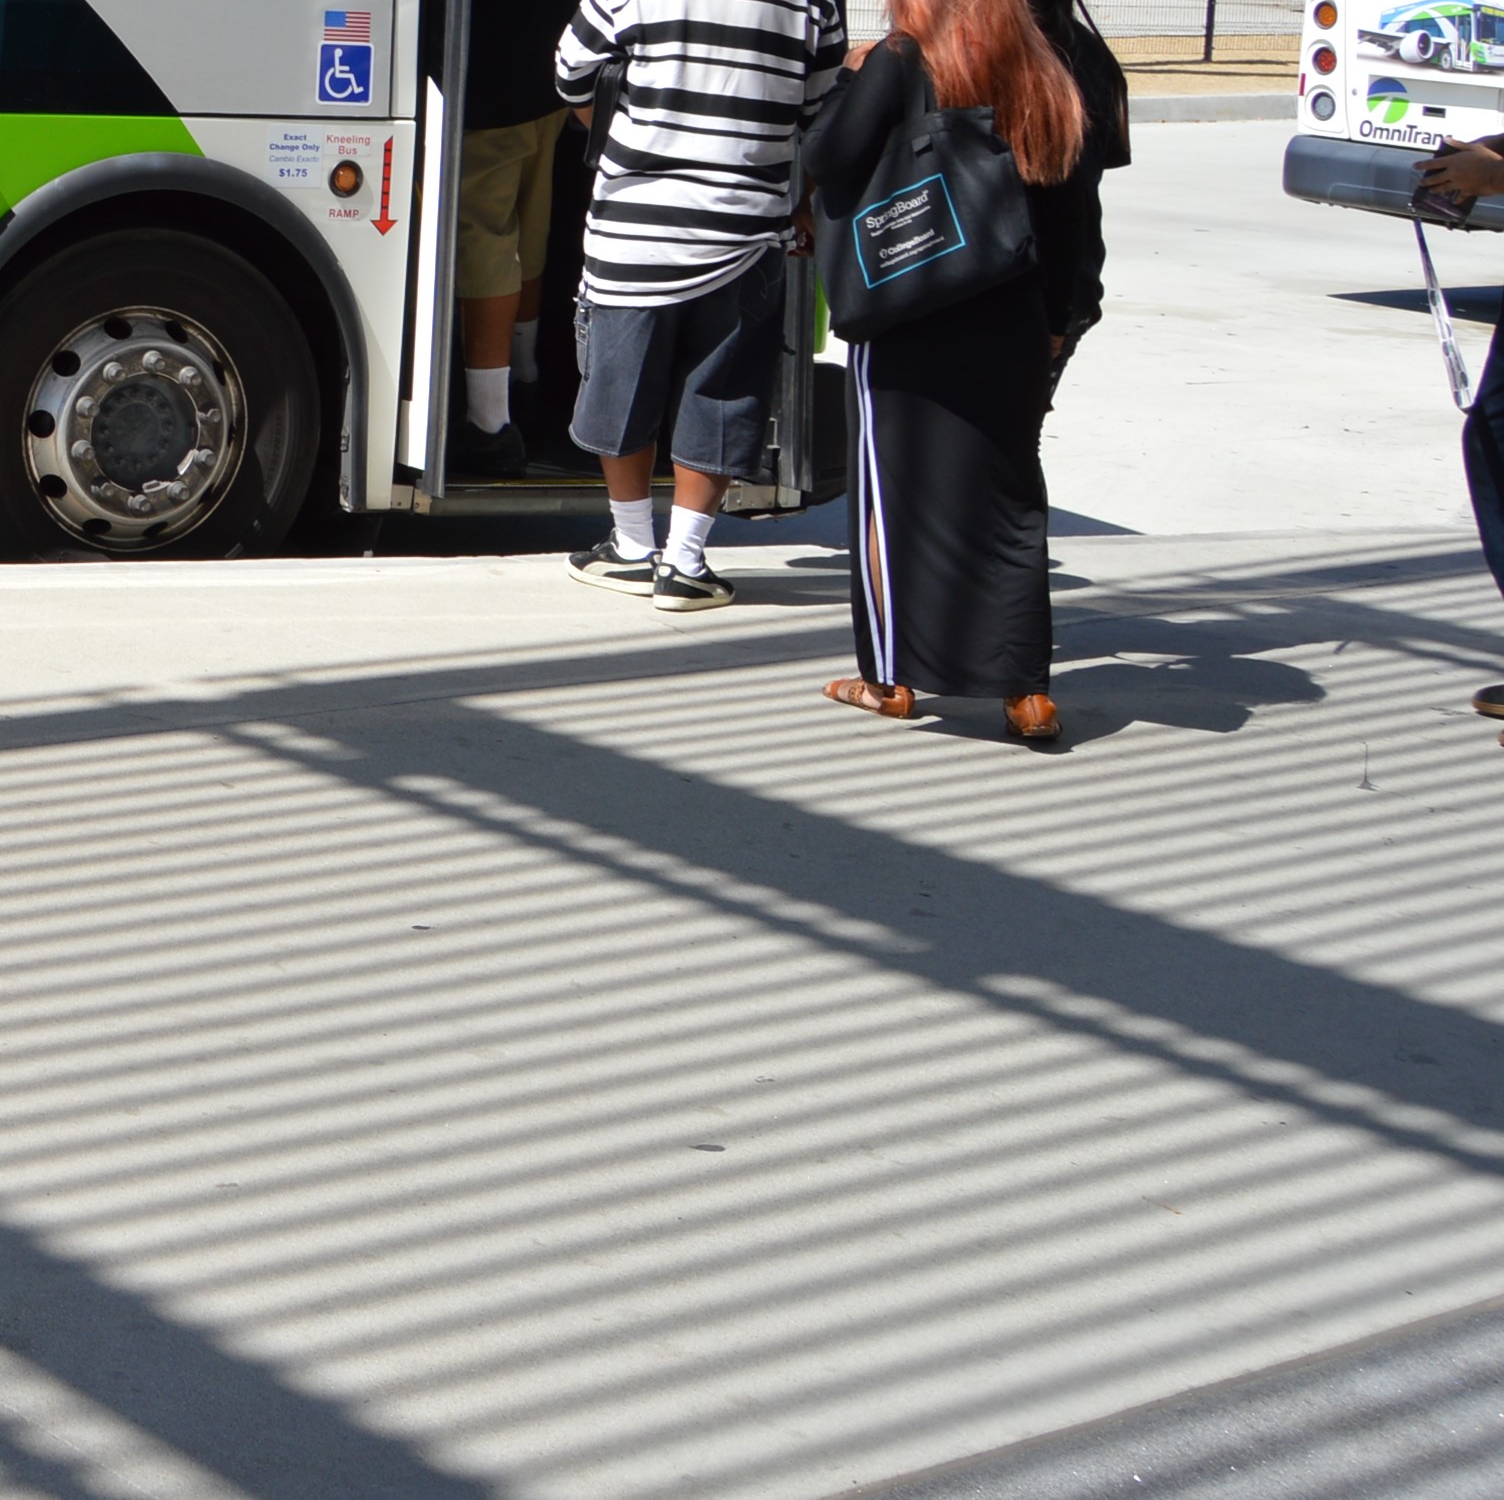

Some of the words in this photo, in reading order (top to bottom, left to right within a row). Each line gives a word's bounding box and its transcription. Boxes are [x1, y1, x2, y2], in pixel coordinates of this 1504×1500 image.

[1359, 120, 1453, 146] OmniTran
[326, 134, 371, 146] Kneeling
[269, 143, 300, 152] Change
[302, 143, 321, 152] Only
[338, 145, 358, 155] Bus
[279, 168, 308, 178] $1.75
[328, 208, 360, 218] RAMP
